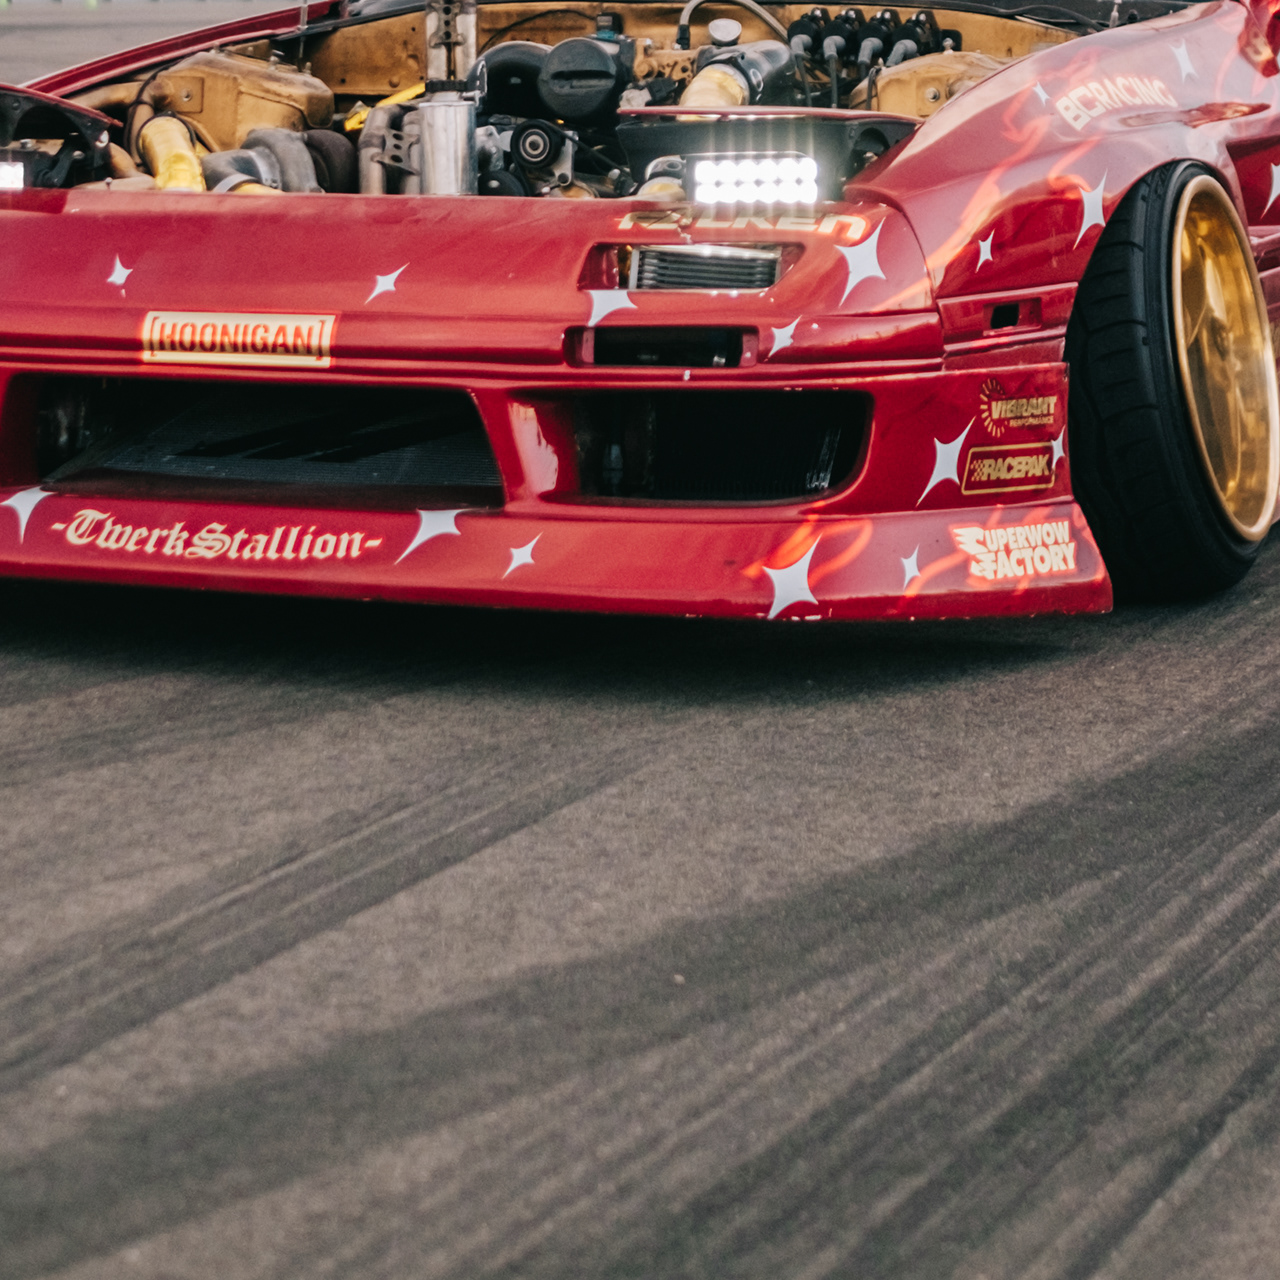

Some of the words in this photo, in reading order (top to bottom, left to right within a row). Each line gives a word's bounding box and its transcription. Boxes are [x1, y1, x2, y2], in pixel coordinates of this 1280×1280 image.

[991, 396, 1058, 419] VIBRANT
[981, 453, 1050, 481] RACEPAK
[953, 520, 1070, 555] SUPERWOW
[970, 542, 1075, 580] FACTORY
